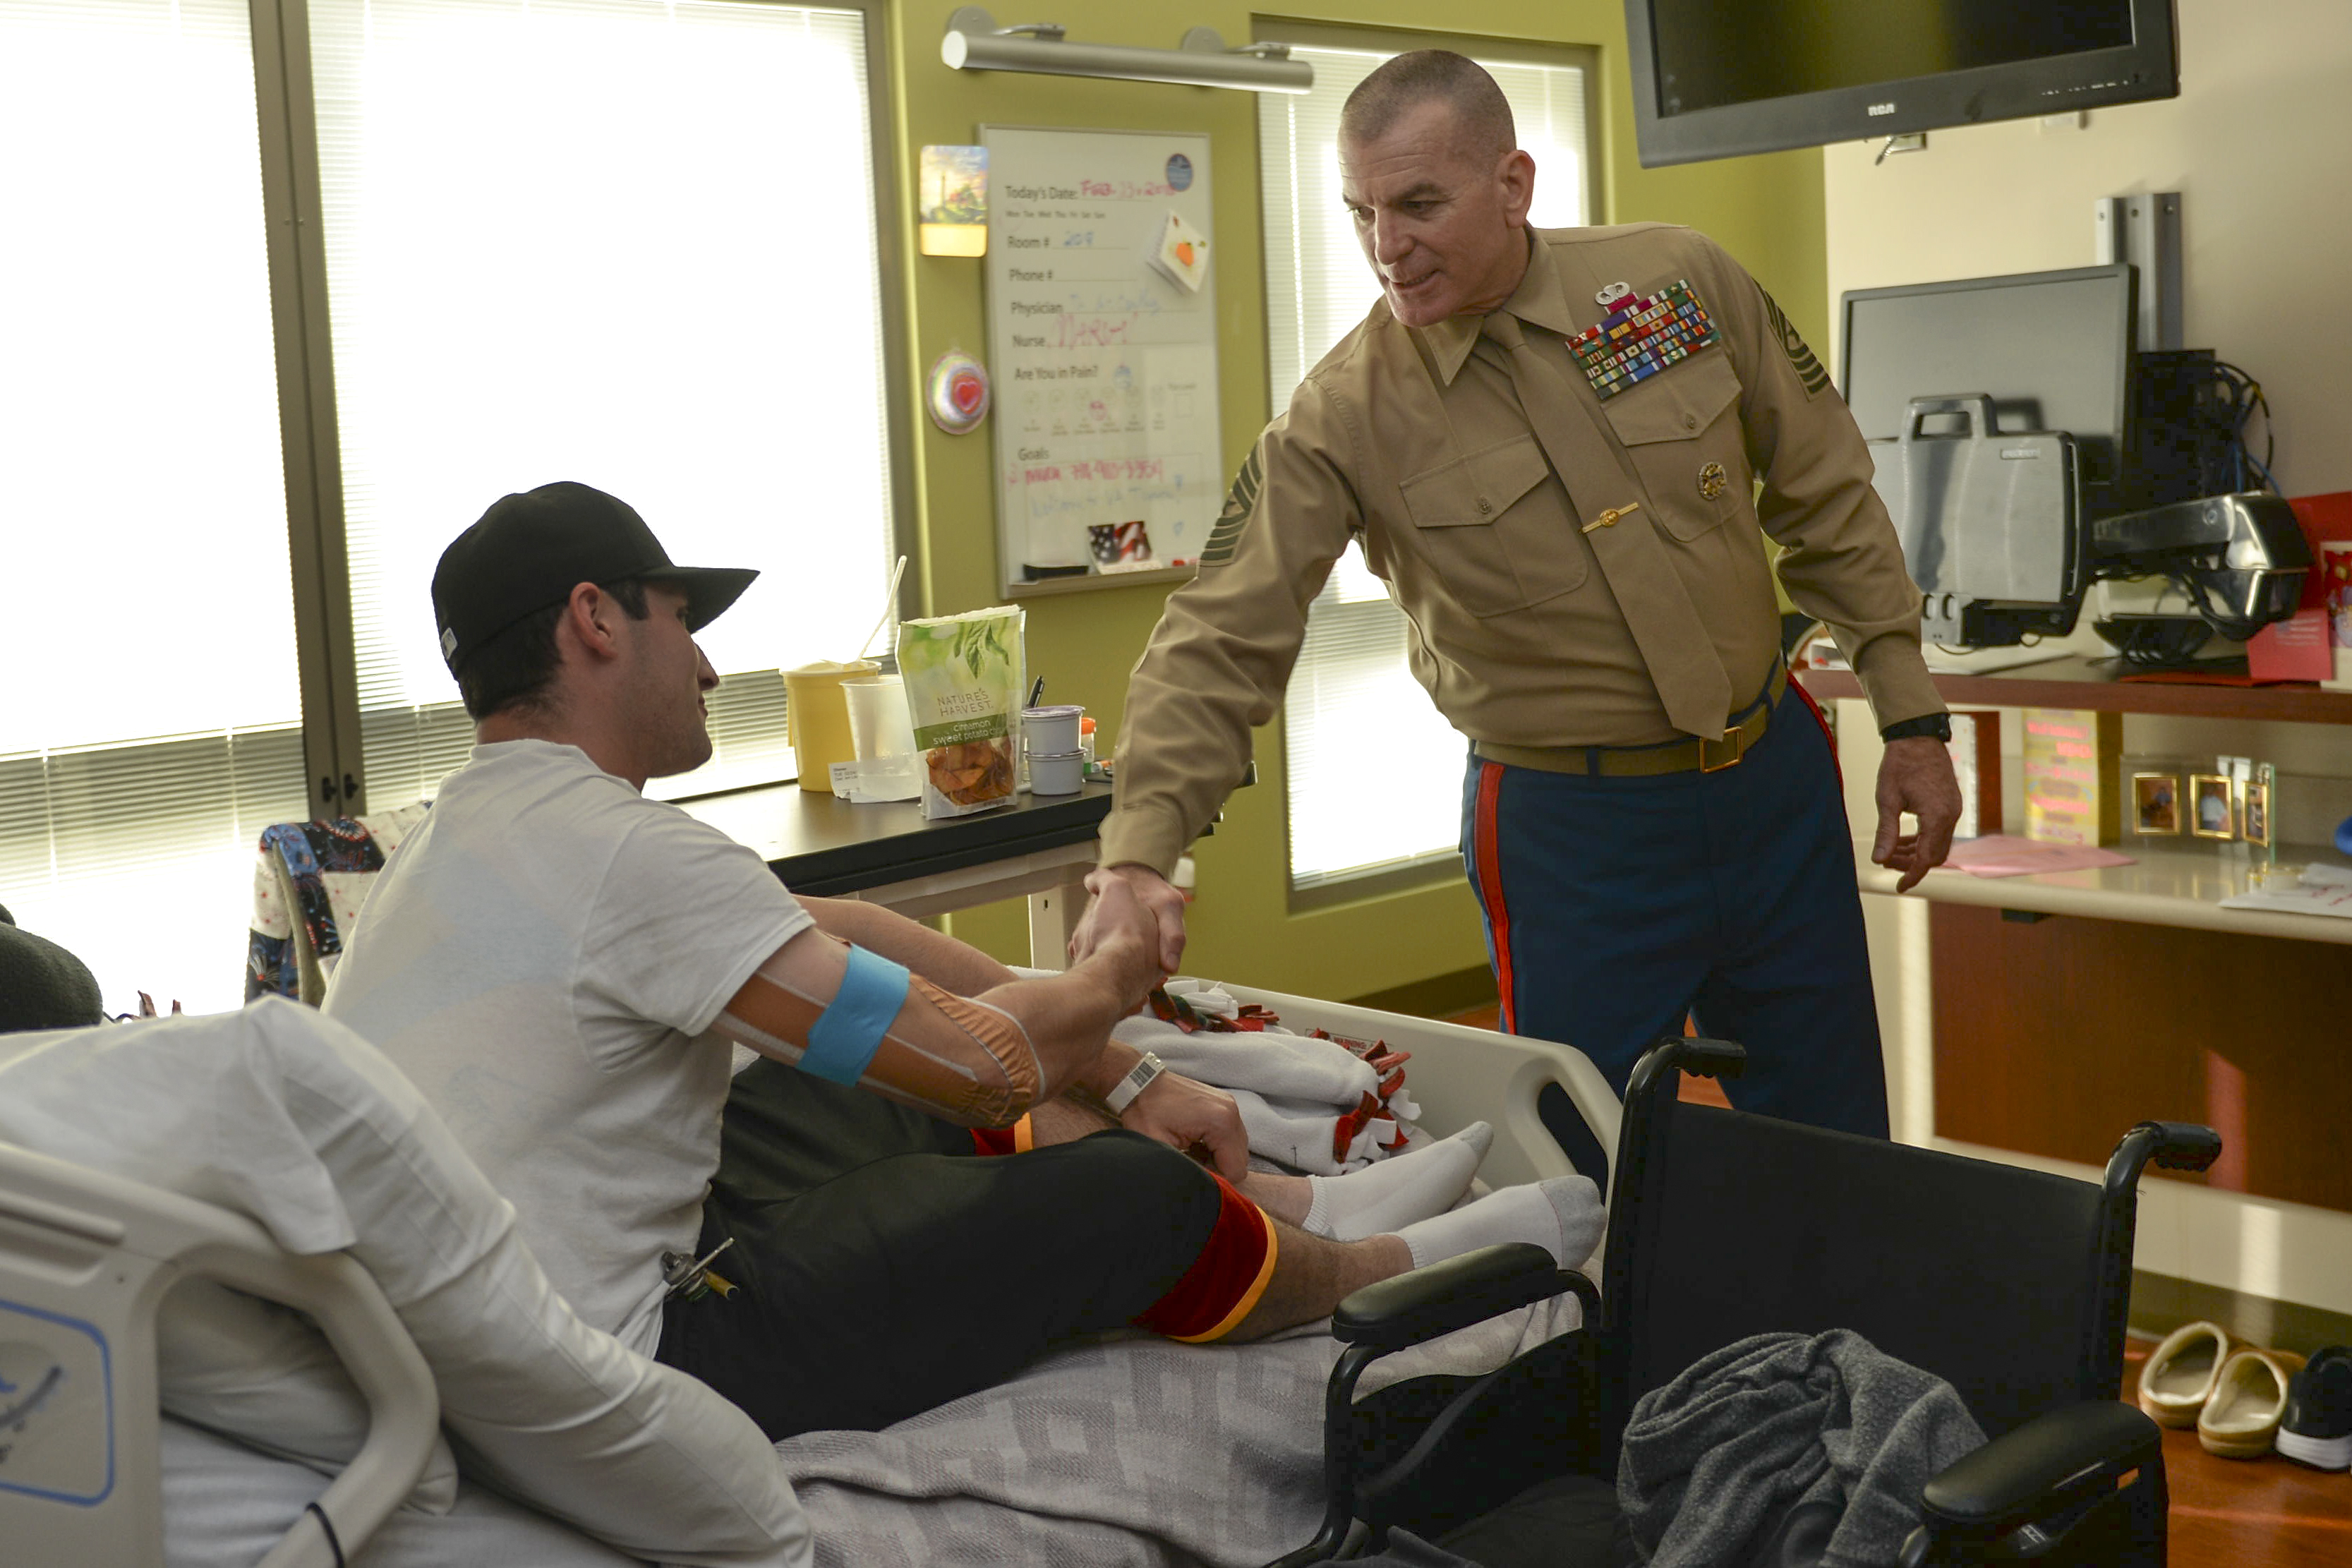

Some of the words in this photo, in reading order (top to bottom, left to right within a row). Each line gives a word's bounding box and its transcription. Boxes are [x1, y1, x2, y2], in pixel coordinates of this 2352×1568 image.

[1005, 186, 1047, 202] Today's
[1049, 186, 1078, 200] Date:
[1007, 236, 1041, 248] Room
[1009, 269, 1044, 282] Phone
[1011, 302, 1063, 317] Physician
[1014, 367, 1034, 380] Are
[1035, 367, 1056, 380] You
[1058, 366, 1068, 380] in
[1070, 365, 1098, 379] Pain?
[937, 687, 989, 706] NATURE'S
[953, 720, 991, 732] cinnamon
[933, 732, 963, 745] sweet
[964, 729, 988, 741] potato
